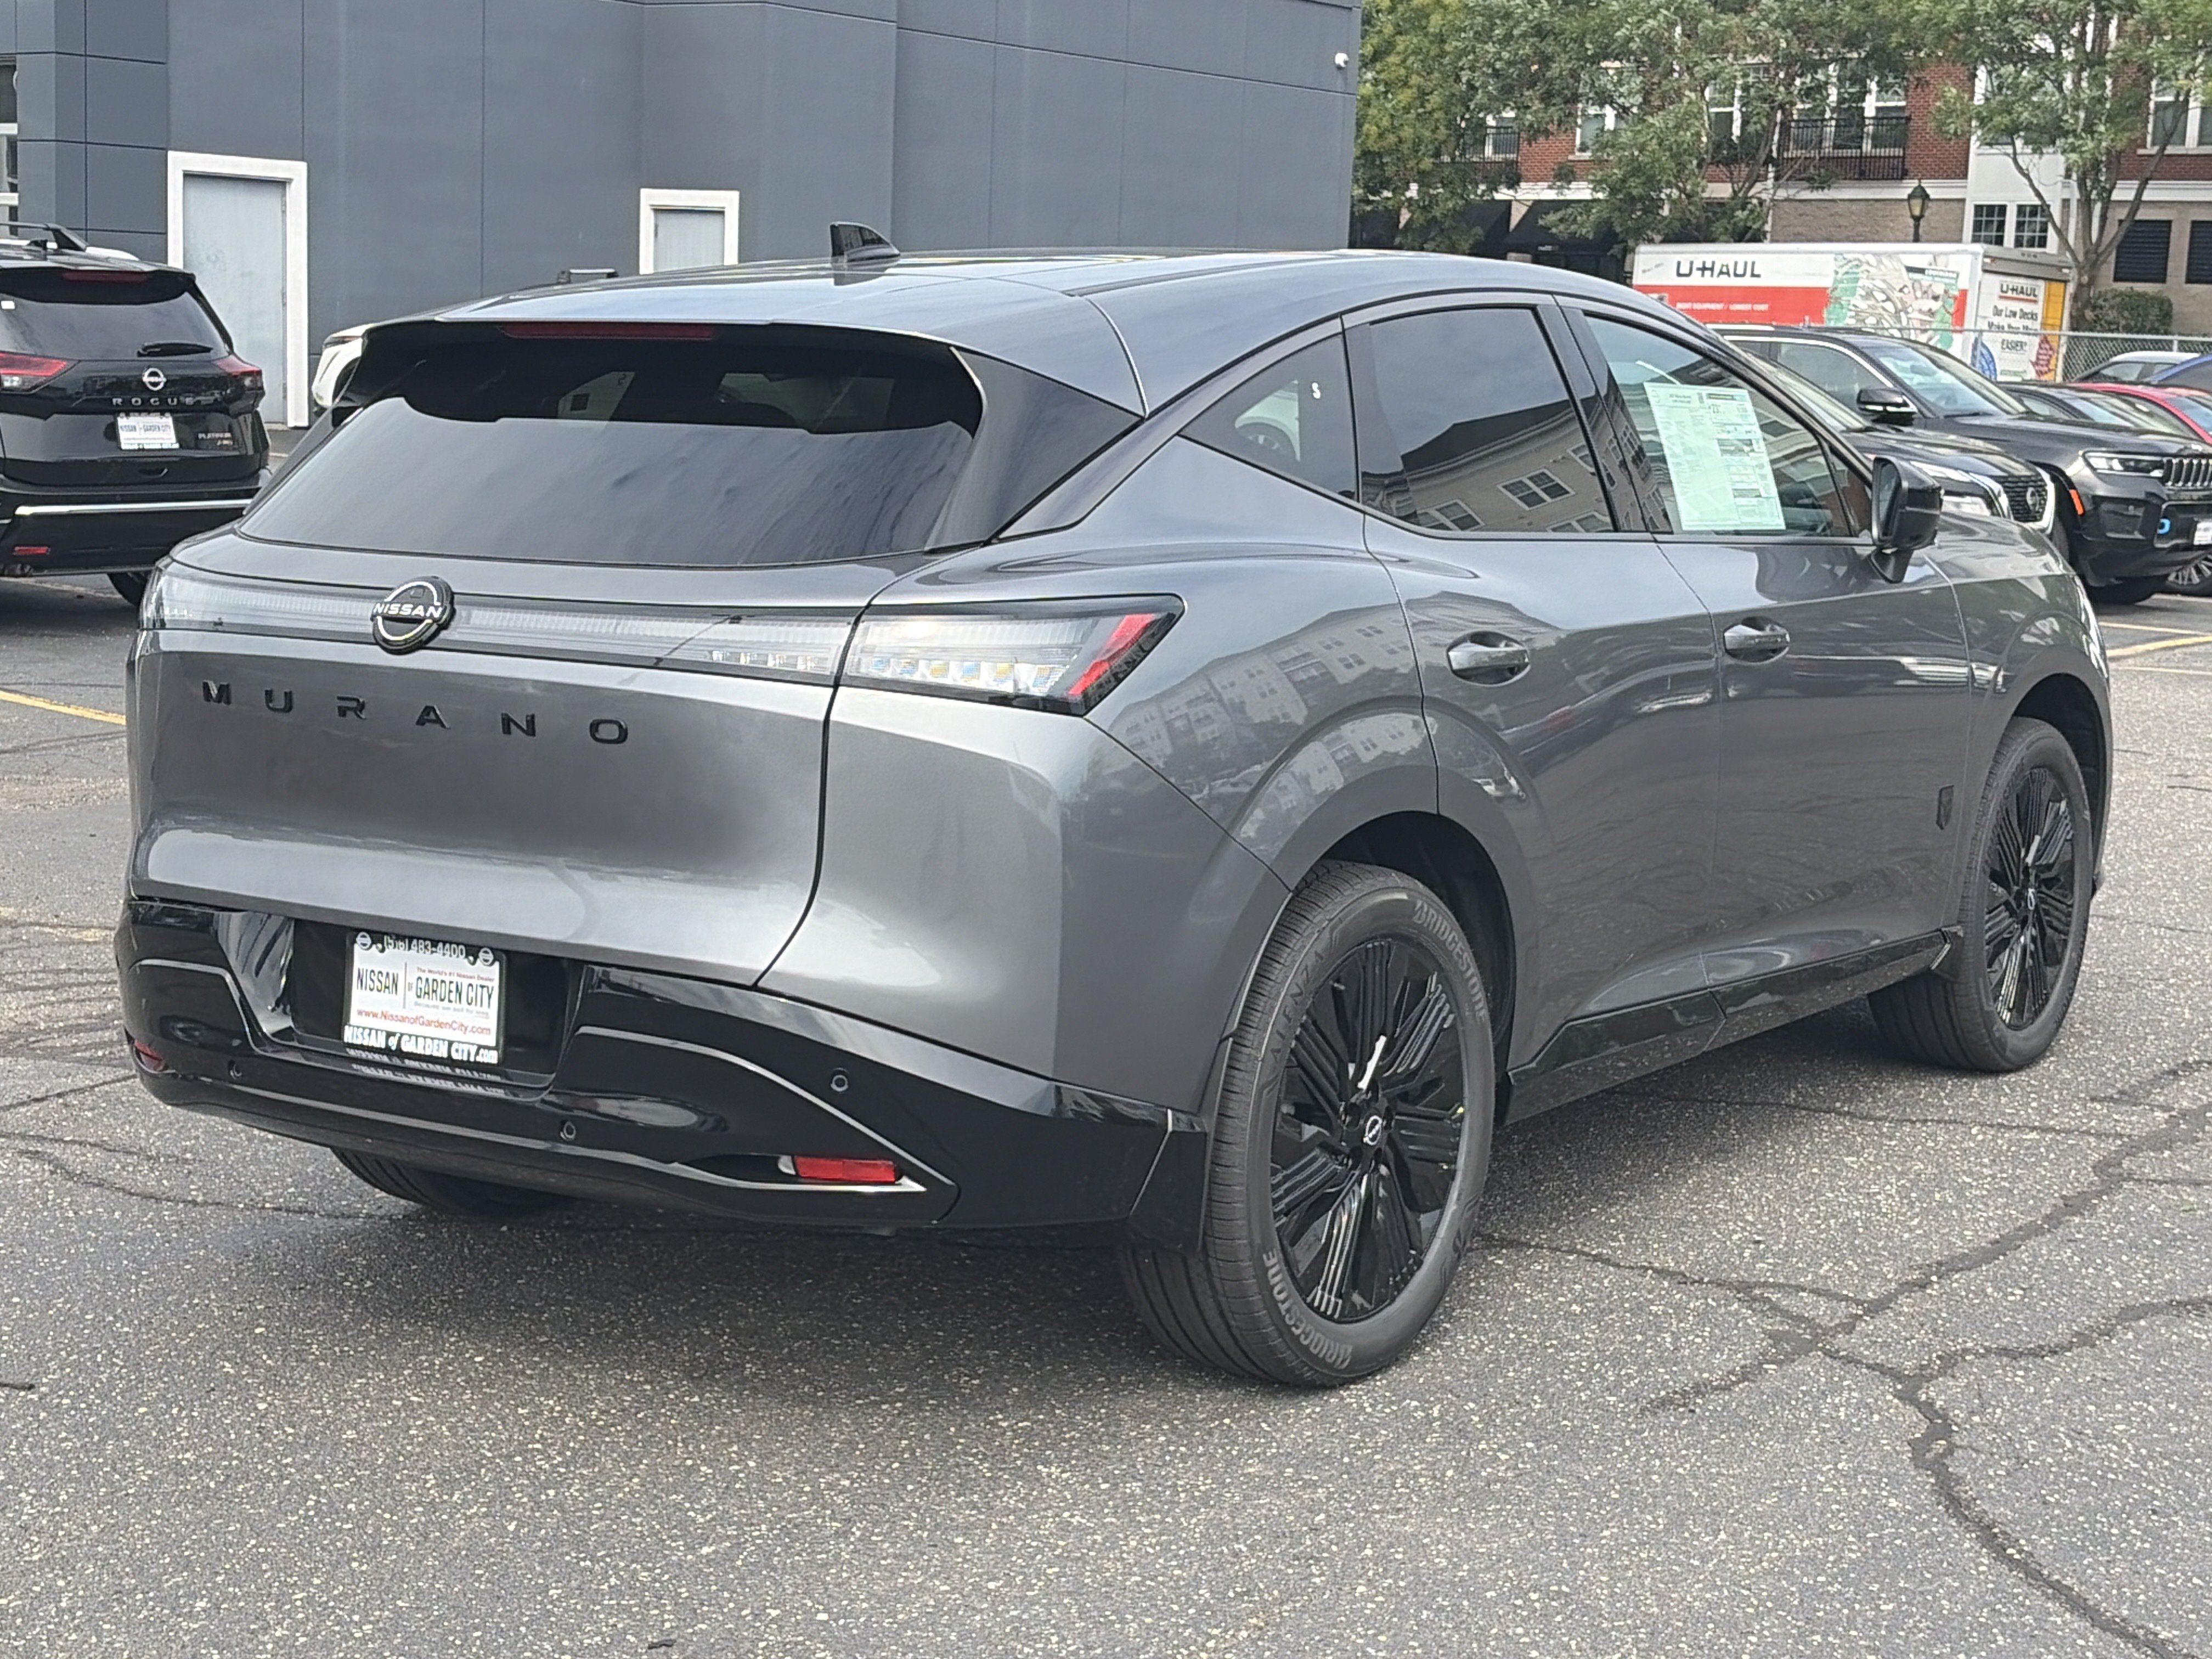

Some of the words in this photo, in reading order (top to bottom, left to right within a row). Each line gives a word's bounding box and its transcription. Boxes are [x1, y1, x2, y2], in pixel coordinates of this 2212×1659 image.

[1676, 261, 1761, 278] U-HAUL
[2000, 283, 2038, 297] U-HAUL
[1993, 305, 2004, 317] Our
[2005, 306, 2017, 319] Low
[2019, 308, 2038, 321] Decks
[112, 397, 194, 405] ROGUE
[374, 603, 443, 618] NISSAN
[202, 679, 629, 745] MURANO
[411, 939, 466, 959] 483-4400
[1413, 900, 1487, 1024] BRIDGESTONE
[357, 967, 399, 995] NISSAN
[415, 976, 463, 1005] GARDEN
[466, 983, 494, 1009] CITY
[357, 1008, 491, 1036] www.NissanofGardenCity.com
[344, 1025, 386, 1048] NISSAN
[388, 1032, 400, 1051] of
[400, 1035, 449, 1058] GARDEN
[1263, 1248, 1353, 1370] BRIDGESTONE
